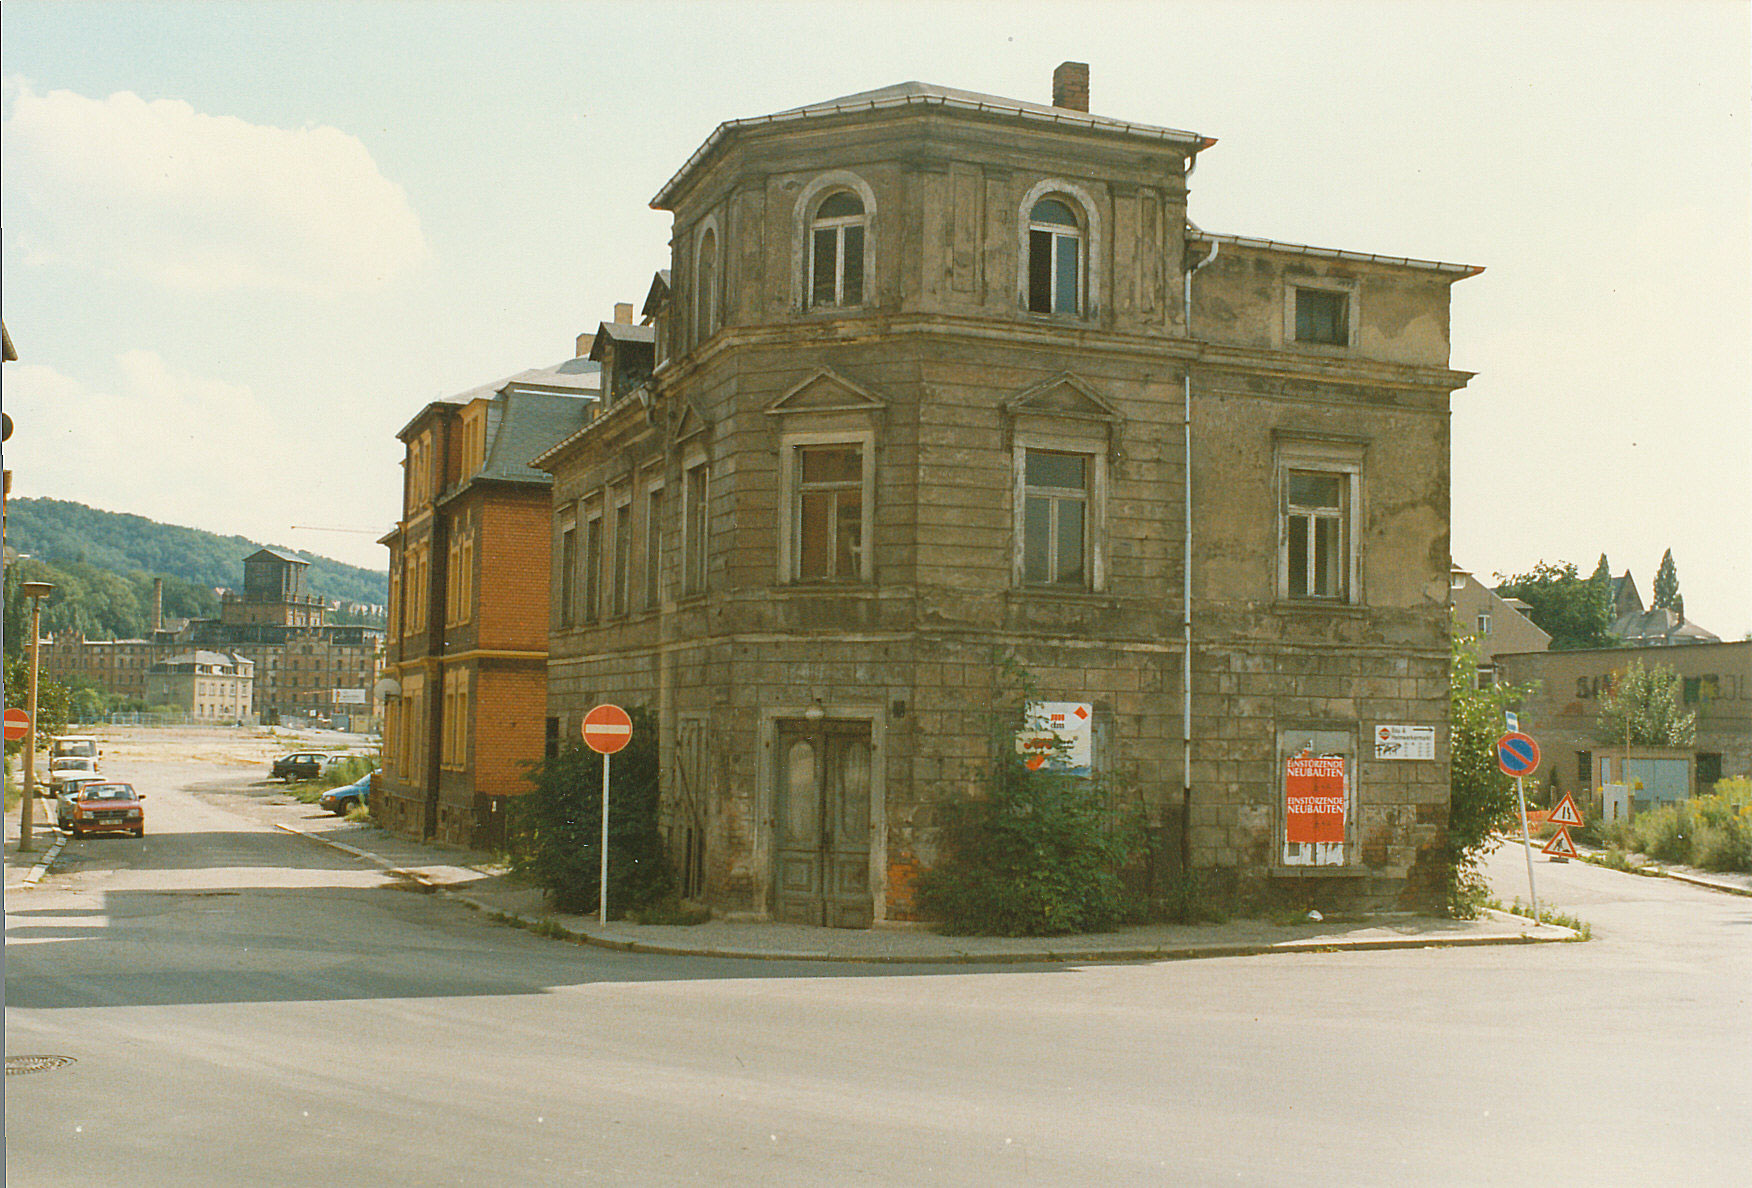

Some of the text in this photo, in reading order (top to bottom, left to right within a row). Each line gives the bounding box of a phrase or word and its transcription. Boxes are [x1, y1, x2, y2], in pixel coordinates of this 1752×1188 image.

[1287, 760, 1344, 768] EINSTÜRZENDE
[1287, 768, 1344, 777] NEUBAUTEN
[1287, 796, 1344, 804] EINSTÜRZENDE
[1287, 804, 1344, 814] NEUBAUTEN
